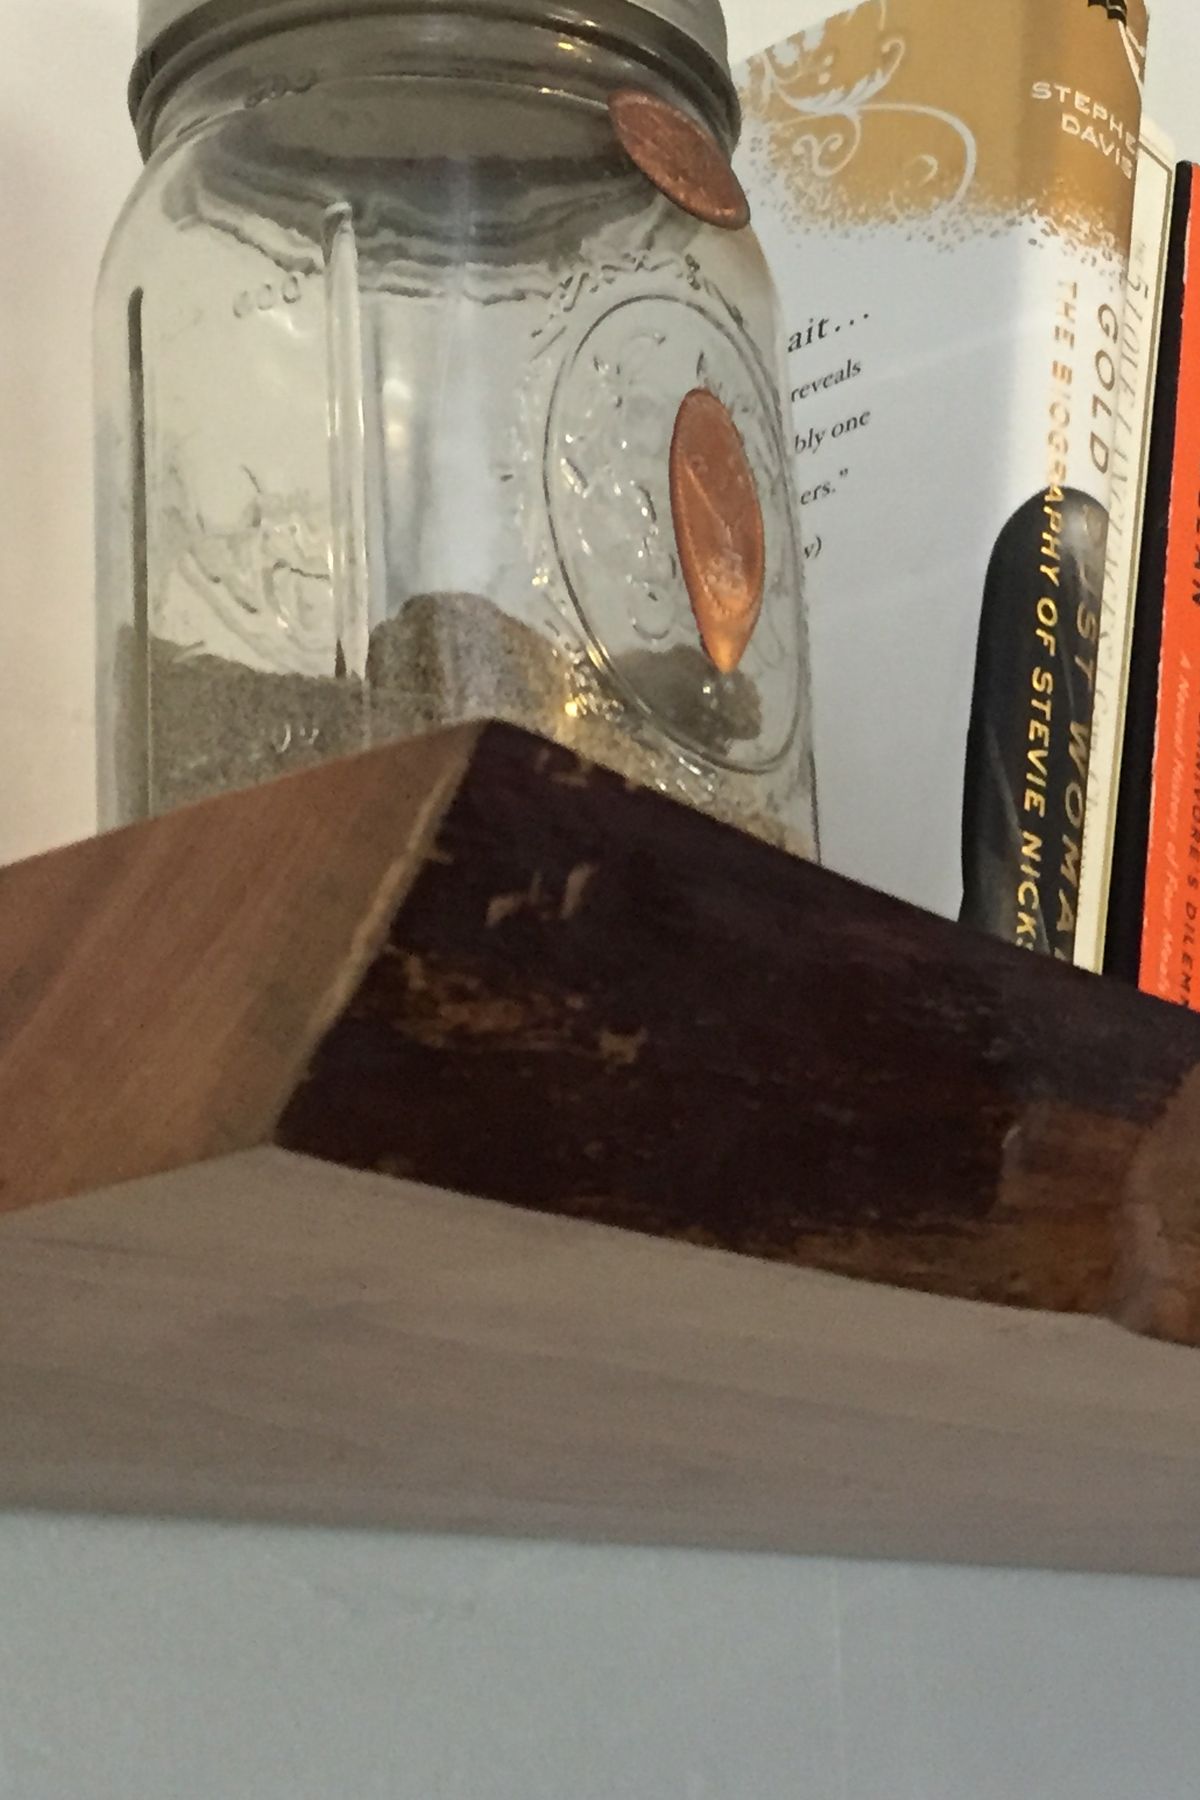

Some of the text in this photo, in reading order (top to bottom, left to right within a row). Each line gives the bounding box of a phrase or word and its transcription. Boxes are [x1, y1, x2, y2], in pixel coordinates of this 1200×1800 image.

[1055, 281, 1078, 350] THE
[790, 358, 862, 402] reveals
[1089, 303, 1119, 474] GOLD
[830, 410, 872, 439] one
[1036, 597, 1059, 656] OF
[1024, 666, 1055, 818] STEVIE
[1054, 720, 1091, 961] WOMA
